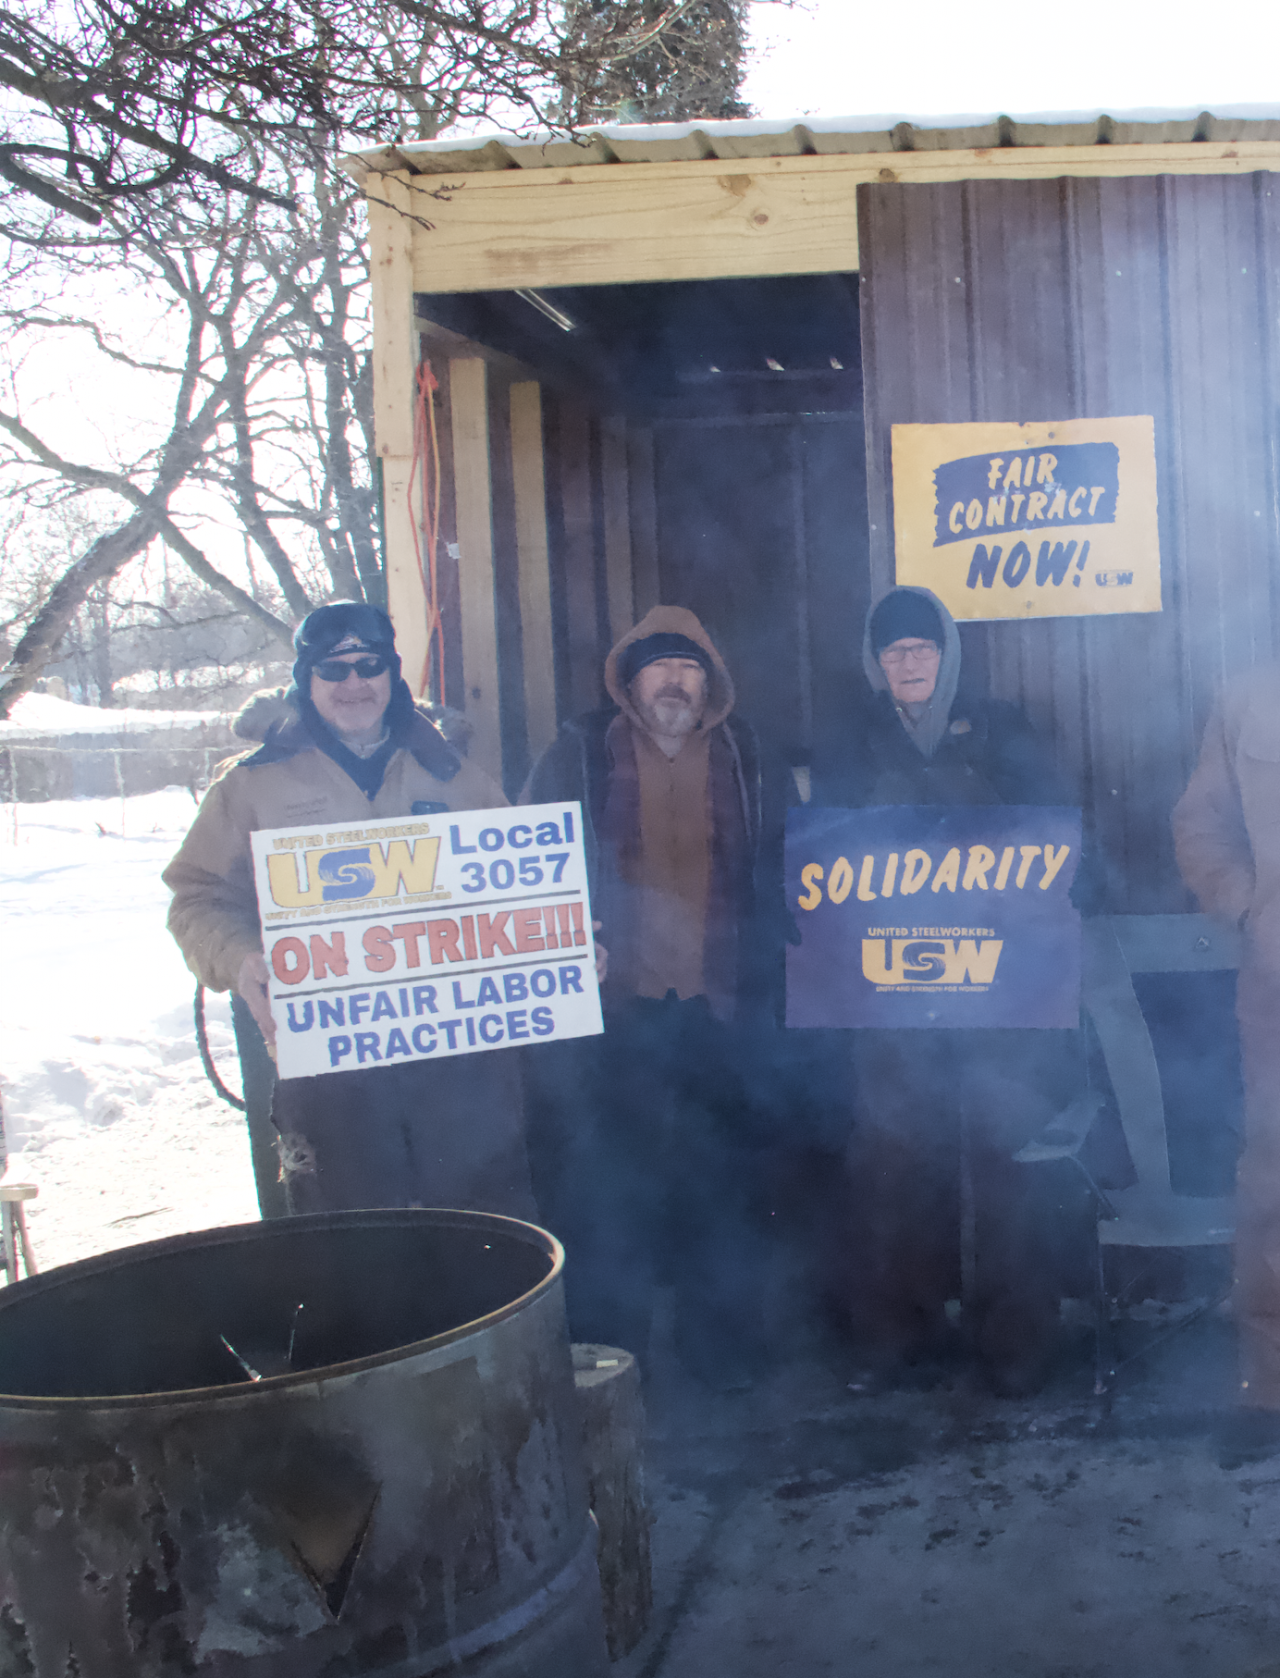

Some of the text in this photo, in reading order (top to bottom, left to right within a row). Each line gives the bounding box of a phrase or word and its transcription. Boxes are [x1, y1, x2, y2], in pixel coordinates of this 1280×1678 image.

[988, 453, 1058, 490] FAIR
[949, 486, 1105, 534] CONTRACT
[966, 539, 1090, 590] NOW!
[273, 822, 430, 851] UNITED STEELWORKERS
[449, 812, 575, 855] Local
[266, 836, 441, 909] USW
[460, 853, 570, 893] 3057
[797, 844, 1070, 911] SOLIDARITY
[271, 902, 587, 985] ON STRIKE!!!
[868, 927, 995, 937] UNITED STEELWORKERS
[862, 939, 1004, 985] USW
[287, 965, 584, 1033] UNFAIR LABOR
[328, 1006, 555, 1067] PRACTICES
